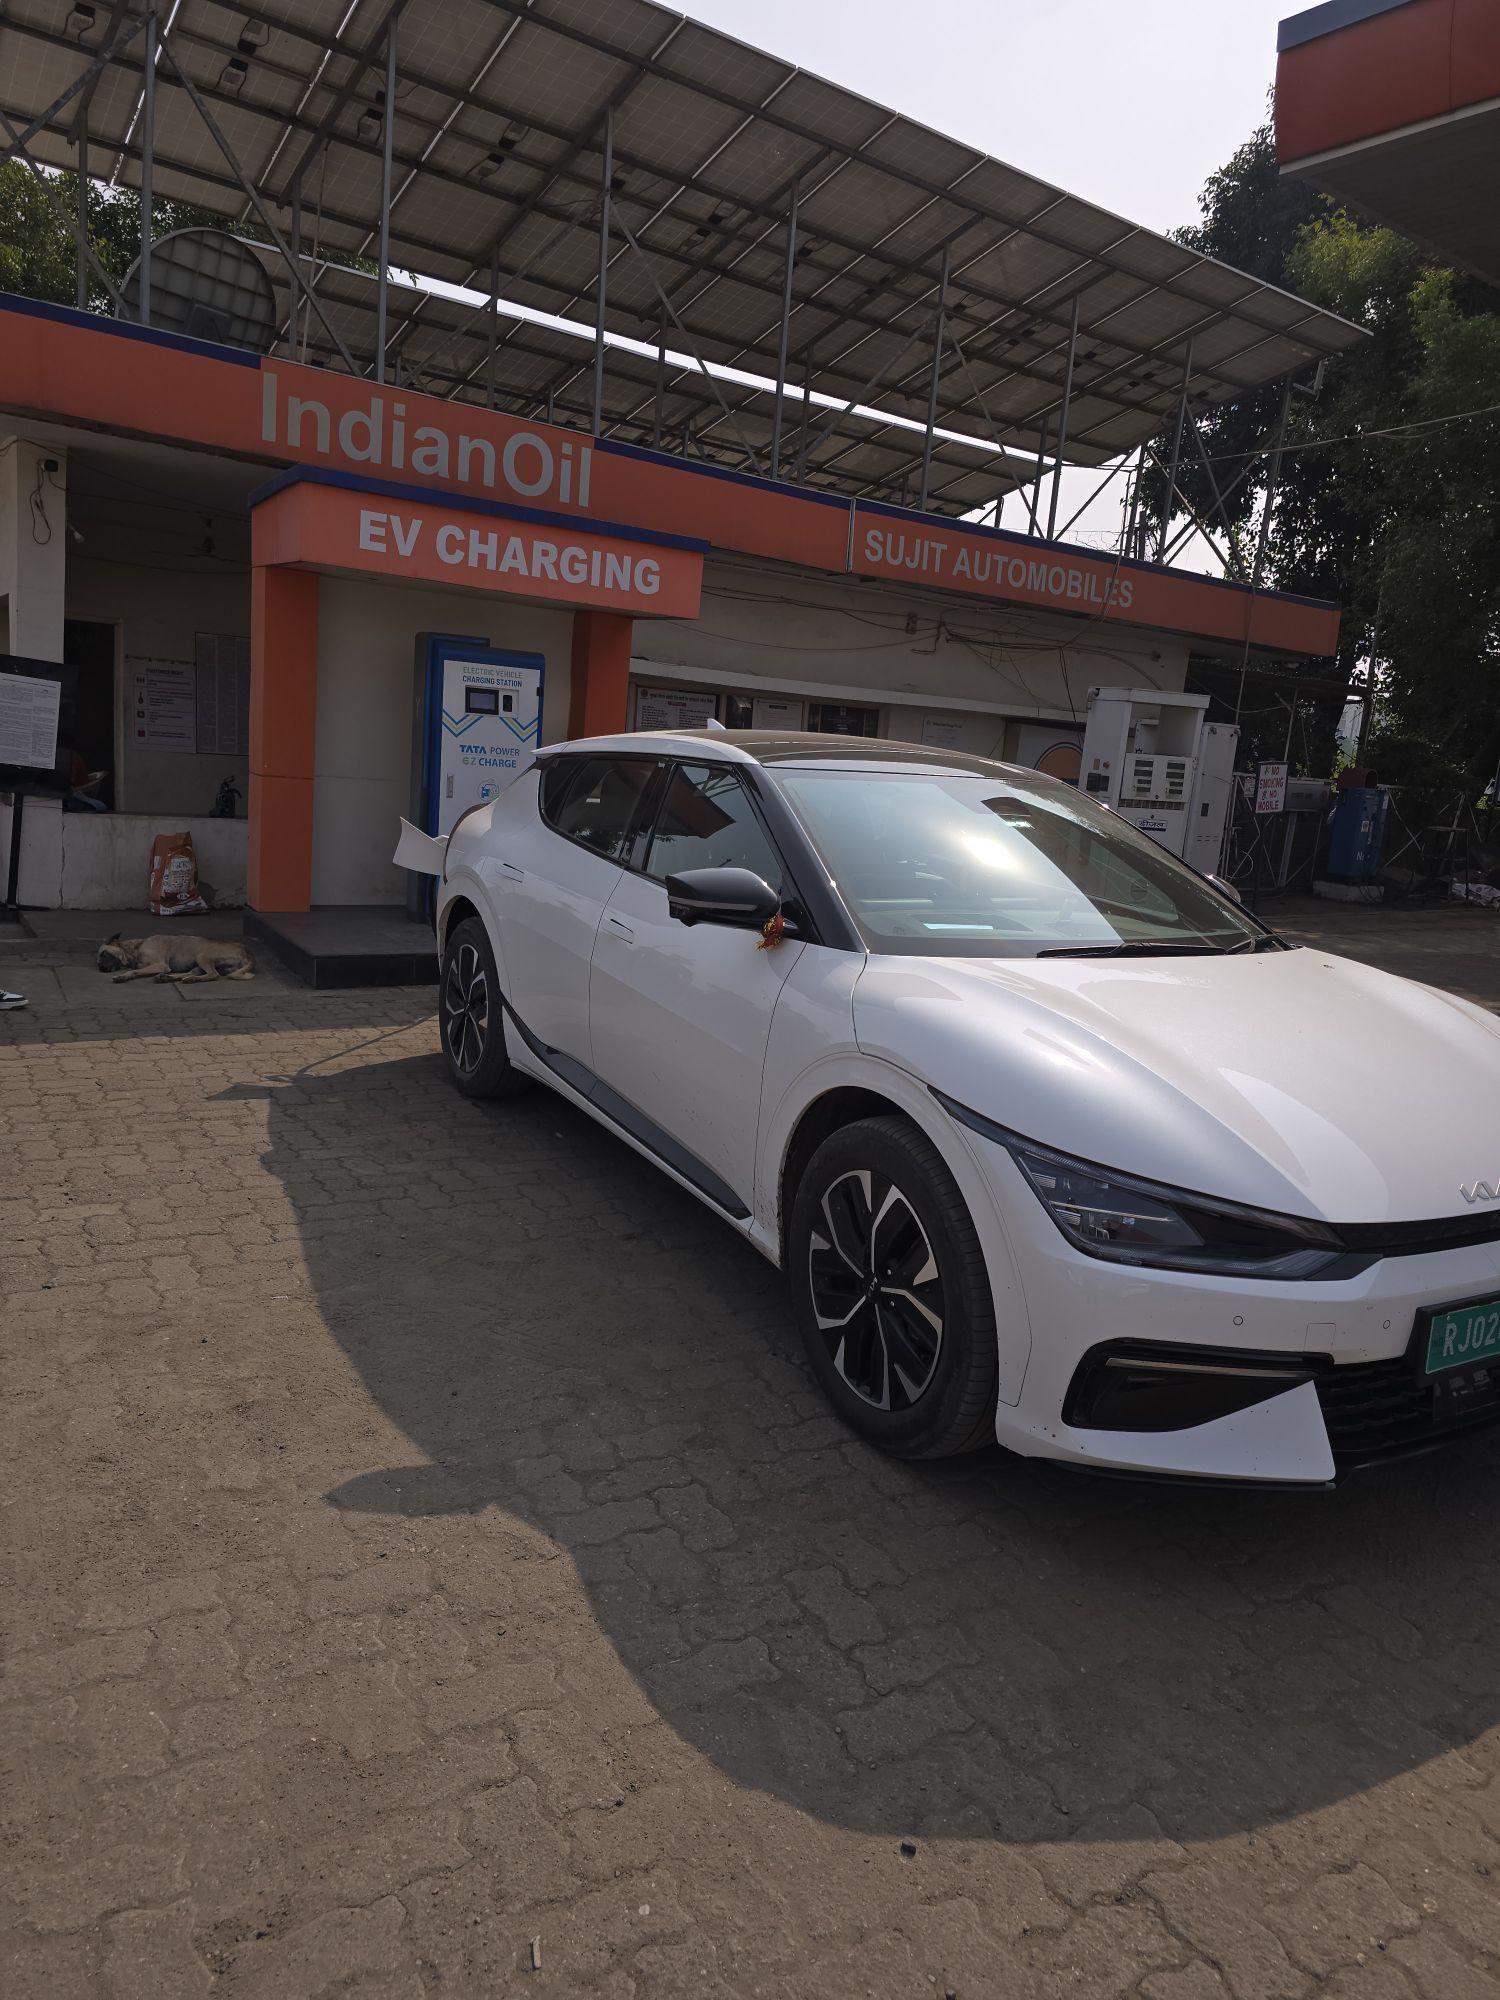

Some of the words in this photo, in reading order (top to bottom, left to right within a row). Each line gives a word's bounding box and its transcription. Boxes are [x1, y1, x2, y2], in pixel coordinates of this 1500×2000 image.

[262, 372, 592, 507] IndianOil
[359, 509, 422, 556] EV
[435, 524, 660, 595] CHARGING
[864, 530, 947, 573] SUJIT
[952, 548, 1133, 608] AUTOMOBILES
[463, 666, 494, 676] ELECTRIC
[496, 669, 523, 679] VEHICLE
[462, 675, 495, 685] CHARGING
[496, 677, 522, 688] STATION
[459, 744, 486, 755] TATA
[490, 747, 520, 757] POWER
[478, 758, 517, 768] CHARGE
[1259, 778, 1284, 789] SMOKING
[1257, 801, 1279, 810] MOBILE
[1442, 1312, 1500, 1357] RJ02
